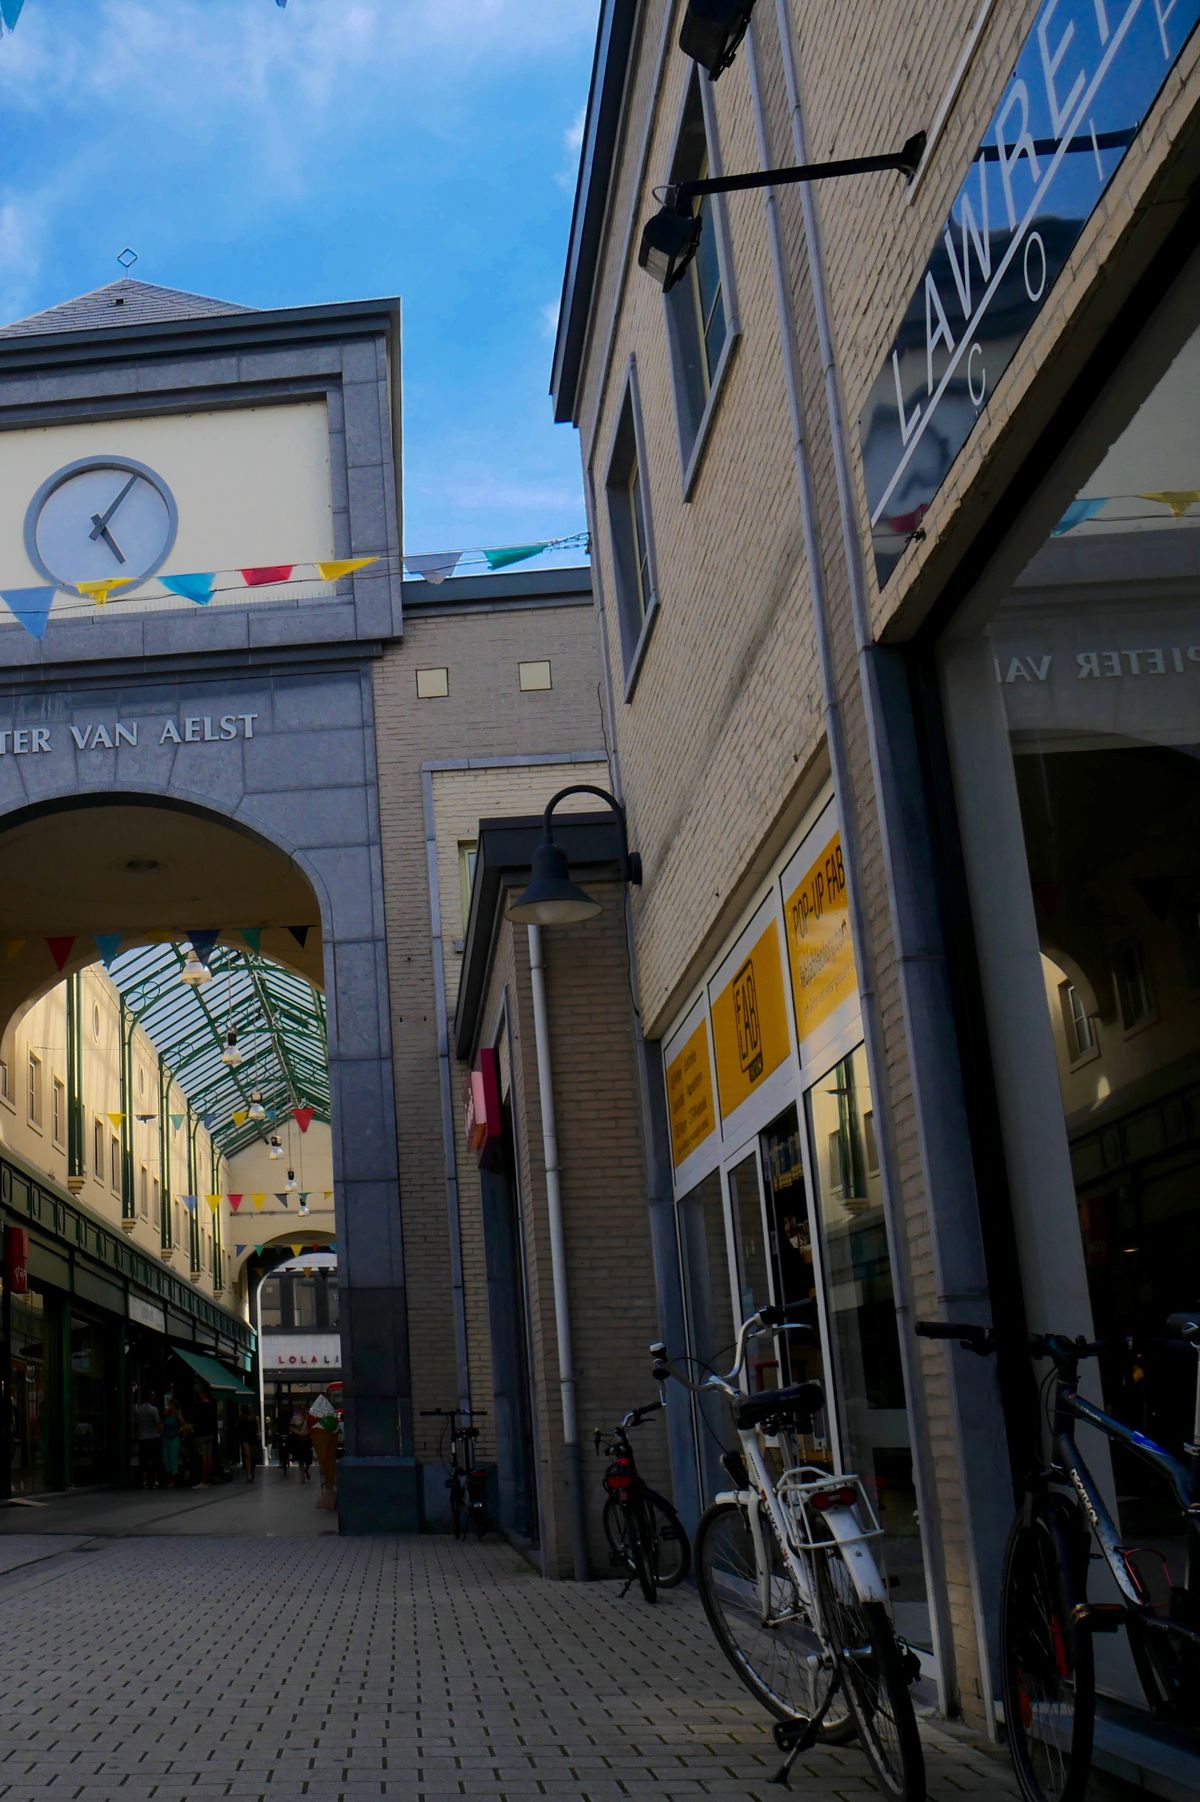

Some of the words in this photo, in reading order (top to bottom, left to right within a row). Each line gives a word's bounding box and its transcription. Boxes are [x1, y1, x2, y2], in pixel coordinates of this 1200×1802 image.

[892, 0, 1110, 446] LAWRE
[70, 721, 139, 751] VAN
[159, 713, 259, 745] AELST
[792, 871, 825, 946] POP-UP
[825, 845, 846, 905] FAB
